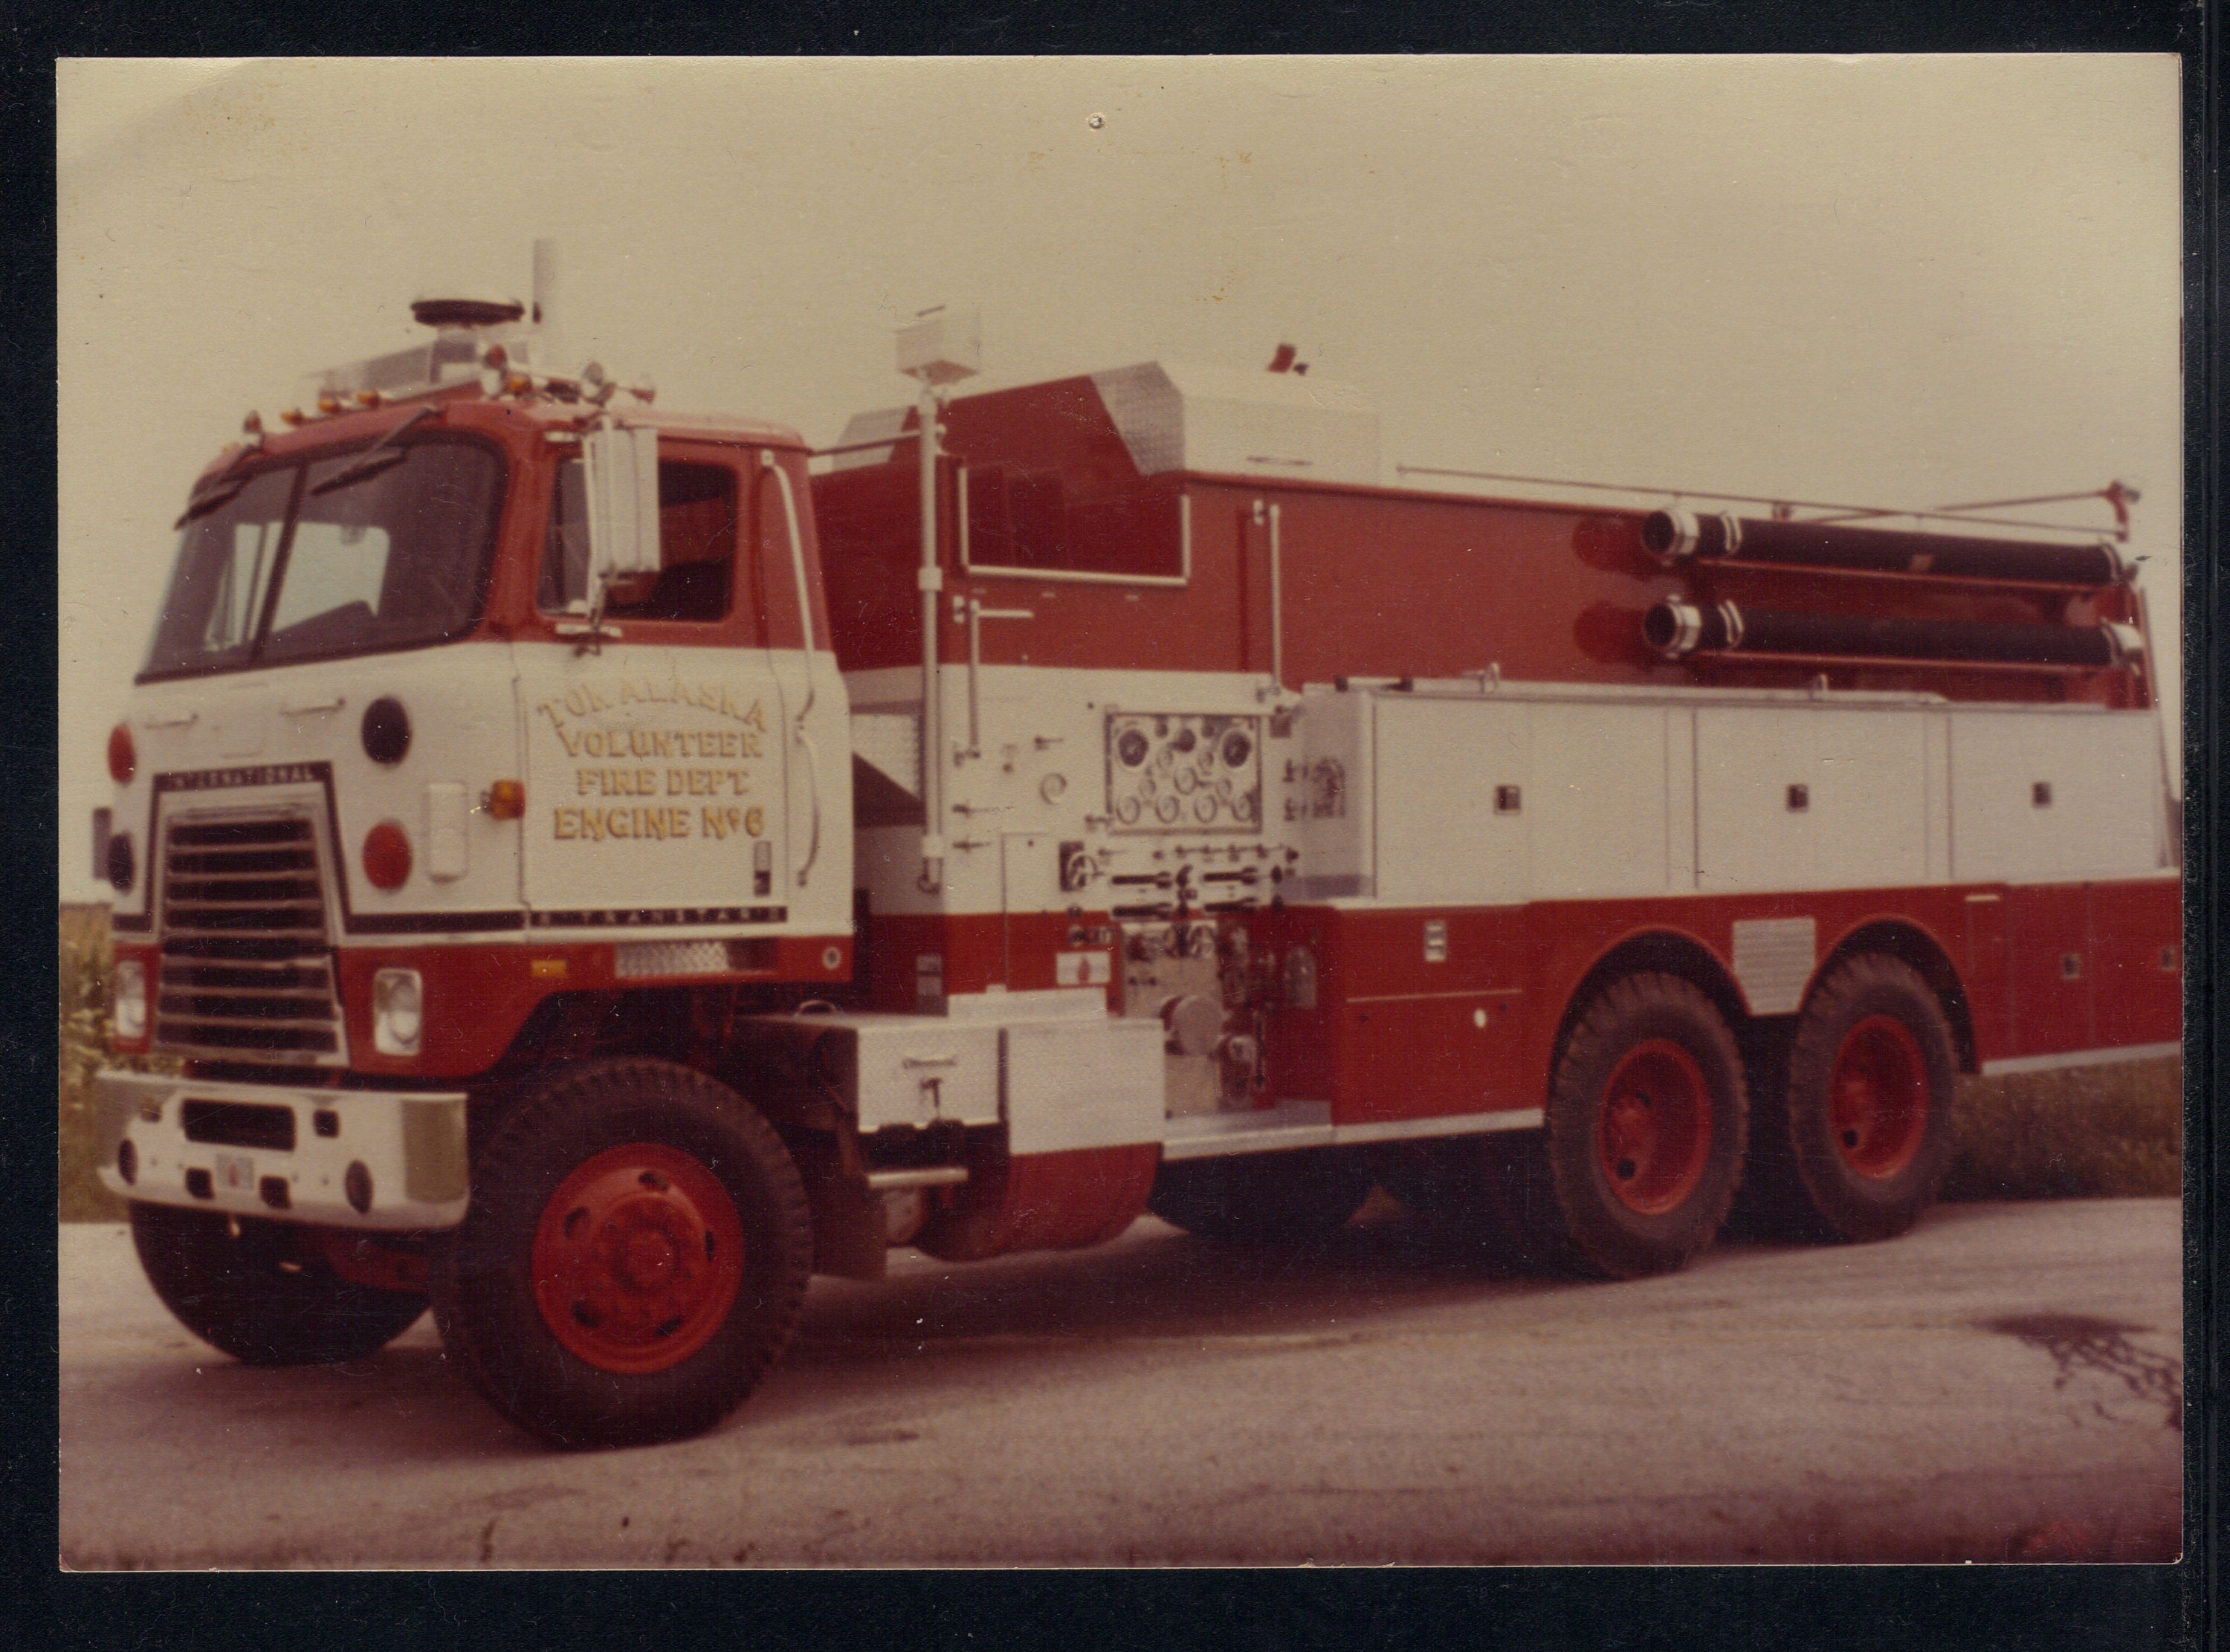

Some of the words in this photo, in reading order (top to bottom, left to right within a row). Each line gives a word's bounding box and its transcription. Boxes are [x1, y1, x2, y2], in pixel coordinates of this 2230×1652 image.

[537, 683, 613, 728] TOK
[620, 677, 767, 732] ALASKA
[557, 731, 763, 758] VOLUNTEER
[575, 768, 657, 796] FIRE
[666, 768, 751, 797] DEPT
[553, 807, 691, 841] ENGINE
